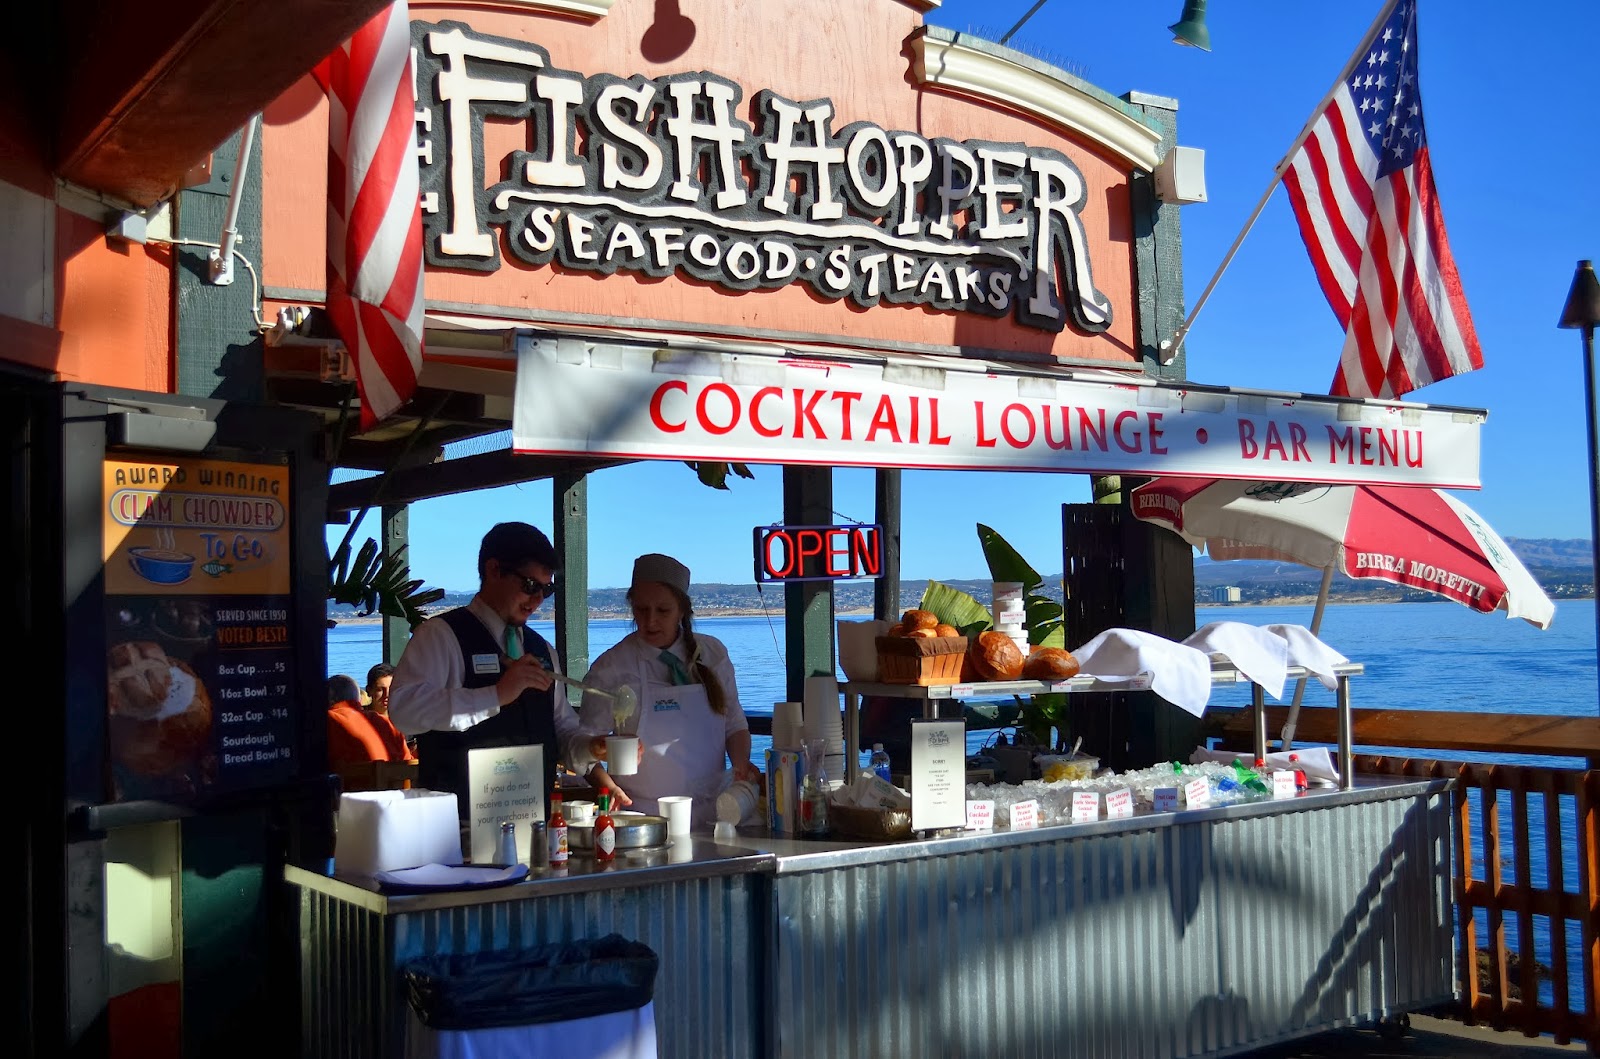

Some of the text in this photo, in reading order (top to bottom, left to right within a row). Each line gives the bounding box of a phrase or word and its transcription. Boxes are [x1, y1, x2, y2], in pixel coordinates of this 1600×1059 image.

[428, 28, 747, 258] FISH
[764, 98, 1110, 325] HOPPER
[524, 207, 1011, 310] SEAFOOD STEAKS
[650, 380, 1424, 469] COCKTAIL LOUNGE BAR MENU
[115, 467, 281, 495] AWARD WINNING
[119, 494, 276, 526] CLAM CHOWDER
[765, 529, 880, 578] OPEN
[1355, 552, 1486, 601] BIRRA MORETTI
[216, 609, 287, 621] SERVED SINCE 1950
[216, 626, 288, 644] VOTED BEST!
[219, 664, 235, 675] 8oz
[237, 663, 256, 676] Cup
[220, 688, 242, 699] 16oz
[244, 685, 267, 697] Bowl
[221, 712, 243, 722] 32oz
[245, 711, 263, 722] Cup
[222, 732, 275, 746] Sourdough
[224, 751, 254, 764] Bread
[256, 748, 279, 760] Bowl
[484, 781, 531, 795] If you do not
[475, 800, 502, 809] receive
[511, 797, 538, 807] receipt,
[477, 810, 538, 826] your purchase is
